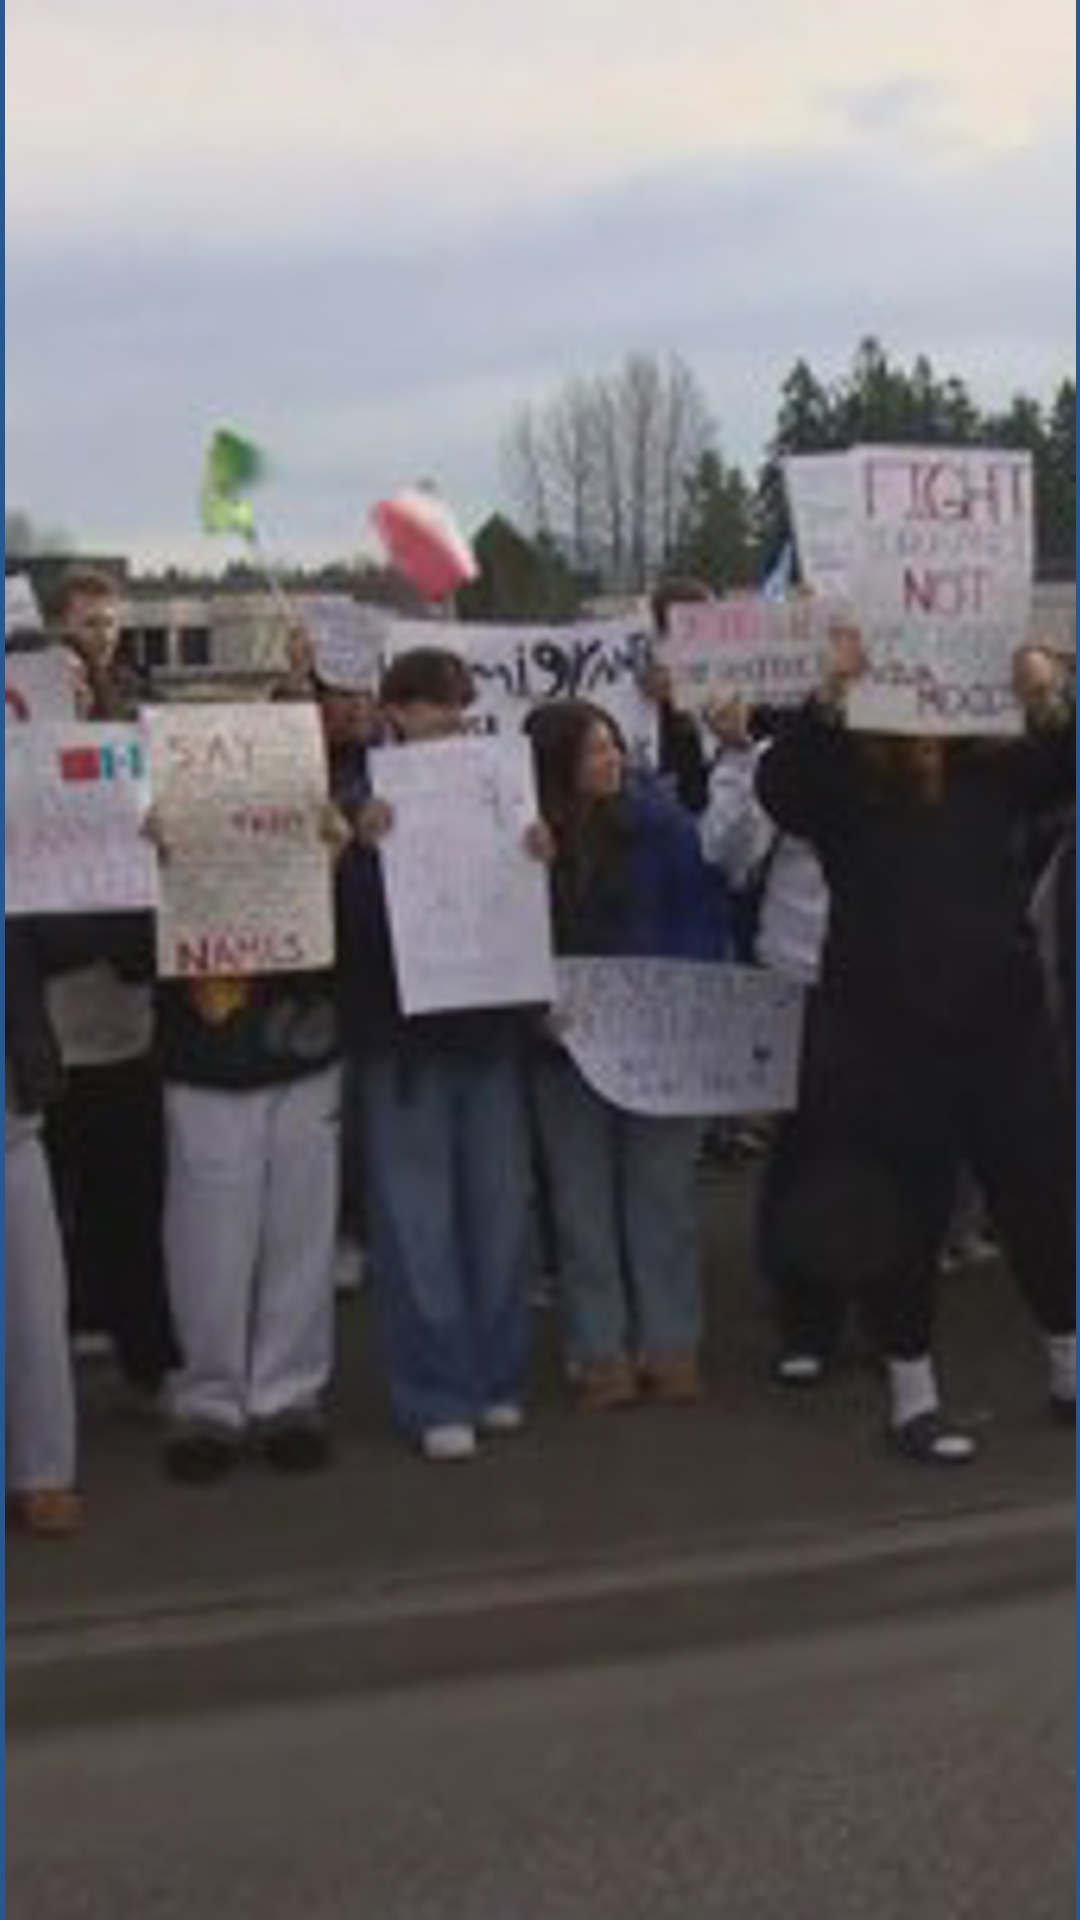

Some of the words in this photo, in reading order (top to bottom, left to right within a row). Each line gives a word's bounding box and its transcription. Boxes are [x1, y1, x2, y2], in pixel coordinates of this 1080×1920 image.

[863, 458, 1026, 523] FIGHT
[903, 566, 991, 616] NOT
[167, 735, 253, 777] SAY
